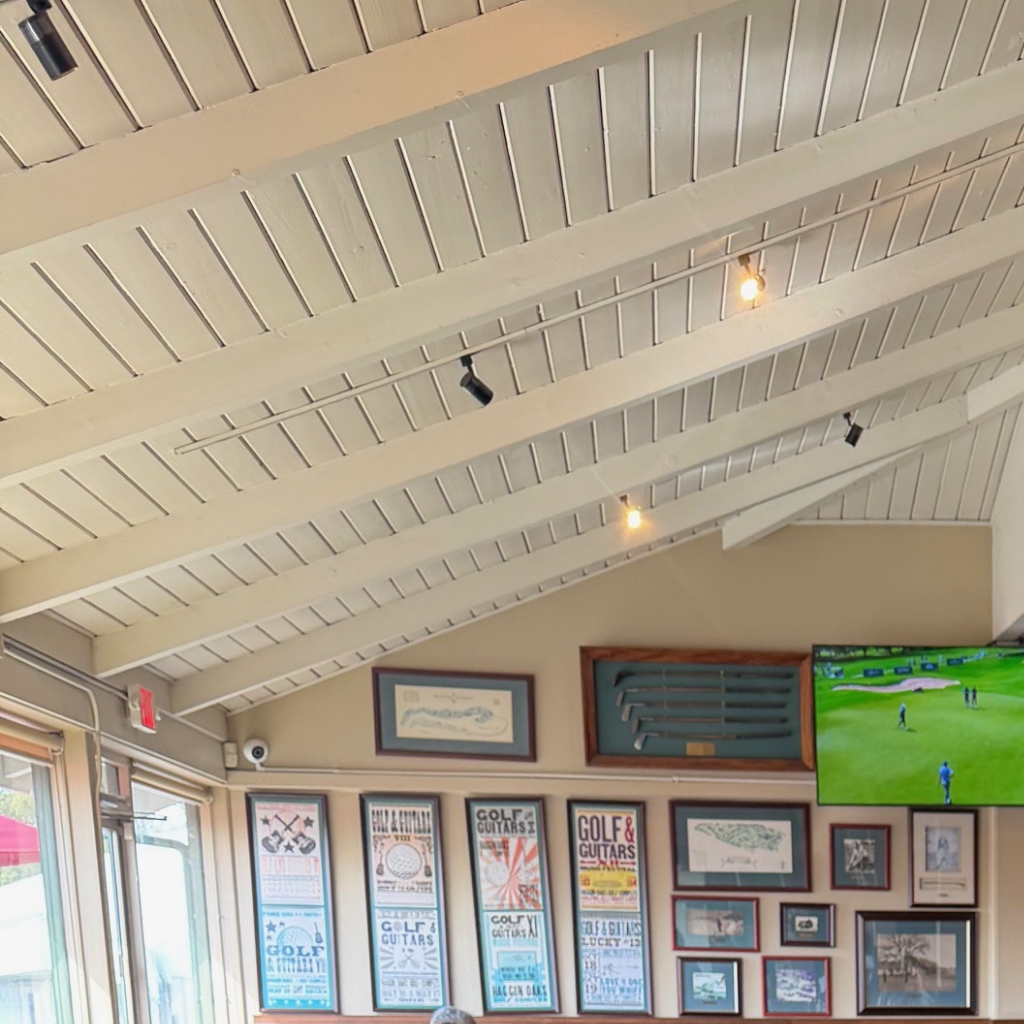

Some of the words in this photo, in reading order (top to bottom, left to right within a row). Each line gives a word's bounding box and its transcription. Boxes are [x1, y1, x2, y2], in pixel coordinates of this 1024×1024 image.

[476, 808, 522, 821] GOLF
[477, 821, 526, 834] GUITARS
[578, 815, 622, 842] GOLF
[624, 816, 635, 843] &
[579, 843, 636, 860] GUITARS
[491, 915, 525, 924] GOLF
[381, 933, 434, 946] GUITARS
[582, 938, 622, 947] LUCKY
[266, 945, 325, 957] GOLF
